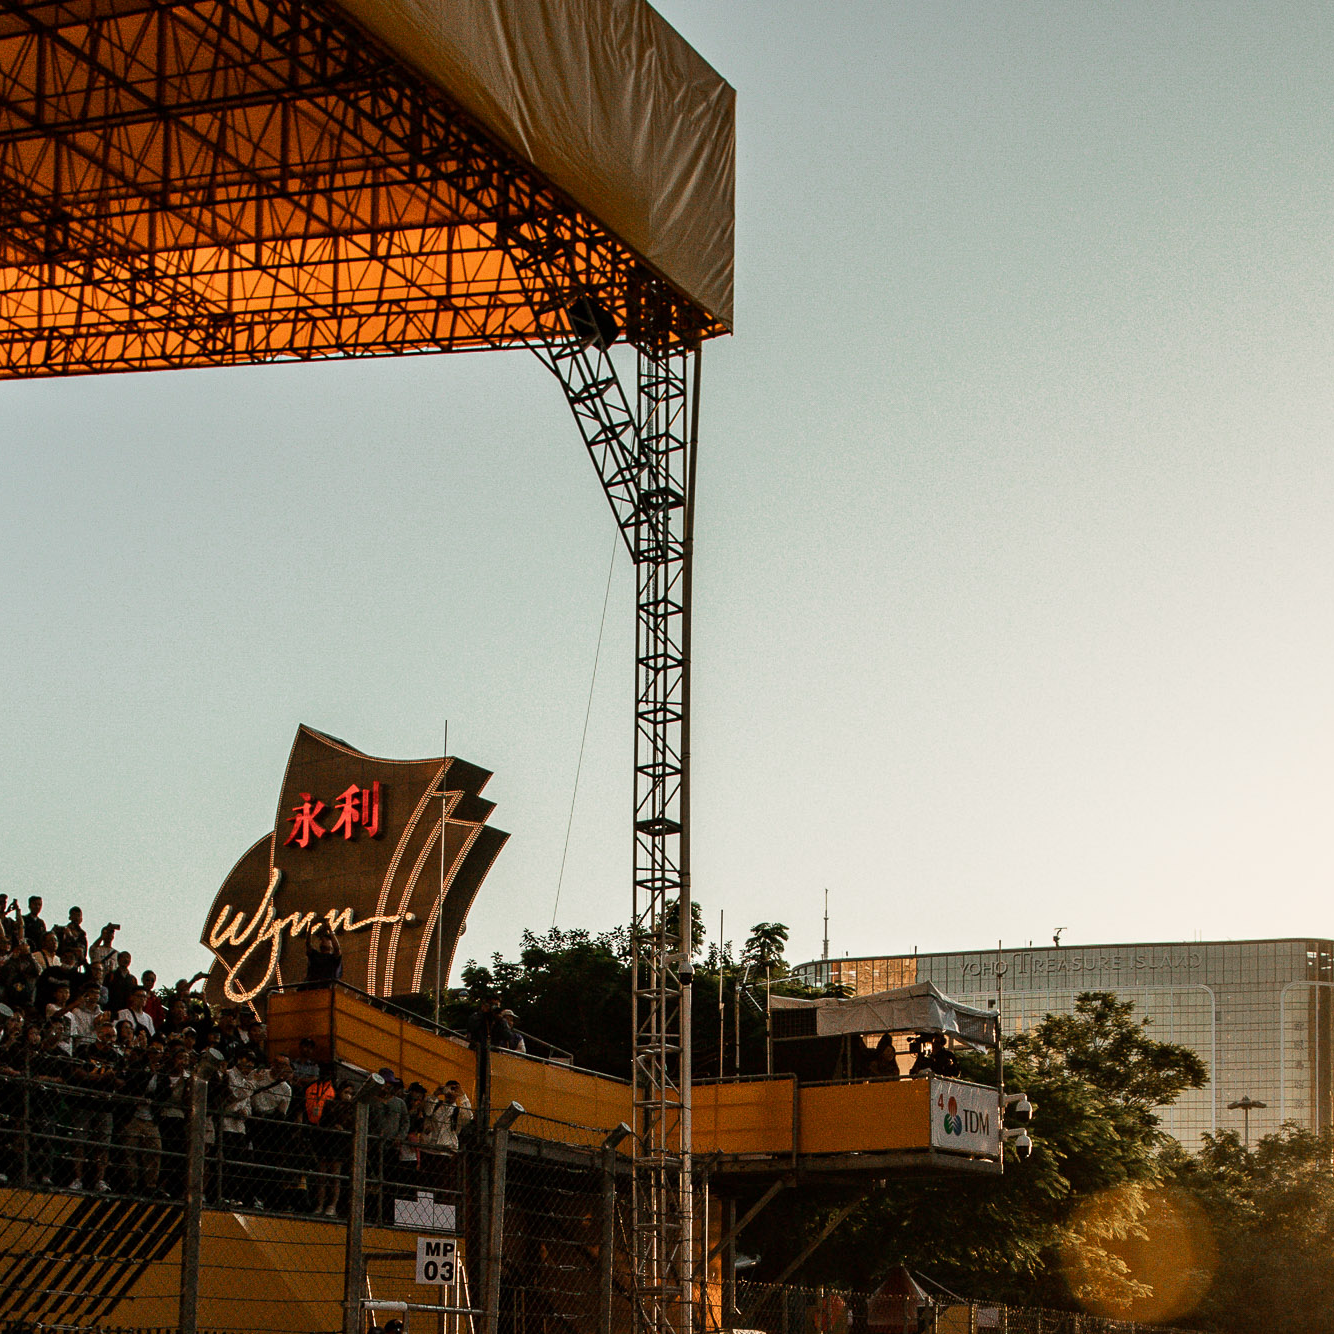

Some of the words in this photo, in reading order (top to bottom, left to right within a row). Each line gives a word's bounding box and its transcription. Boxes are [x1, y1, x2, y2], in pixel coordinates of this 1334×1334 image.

[284, 779, 387, 849] 永利
[960, 960, 1009, 976] YOHO
[1013, 952, 1122, 973] TREASURE
[937, 1093, 945, 1111] 4
[963, 1109, 990, 1136] TDM
[425, 1241, 455, 1257] MP
[424, 1260, 454, 1282] 03
